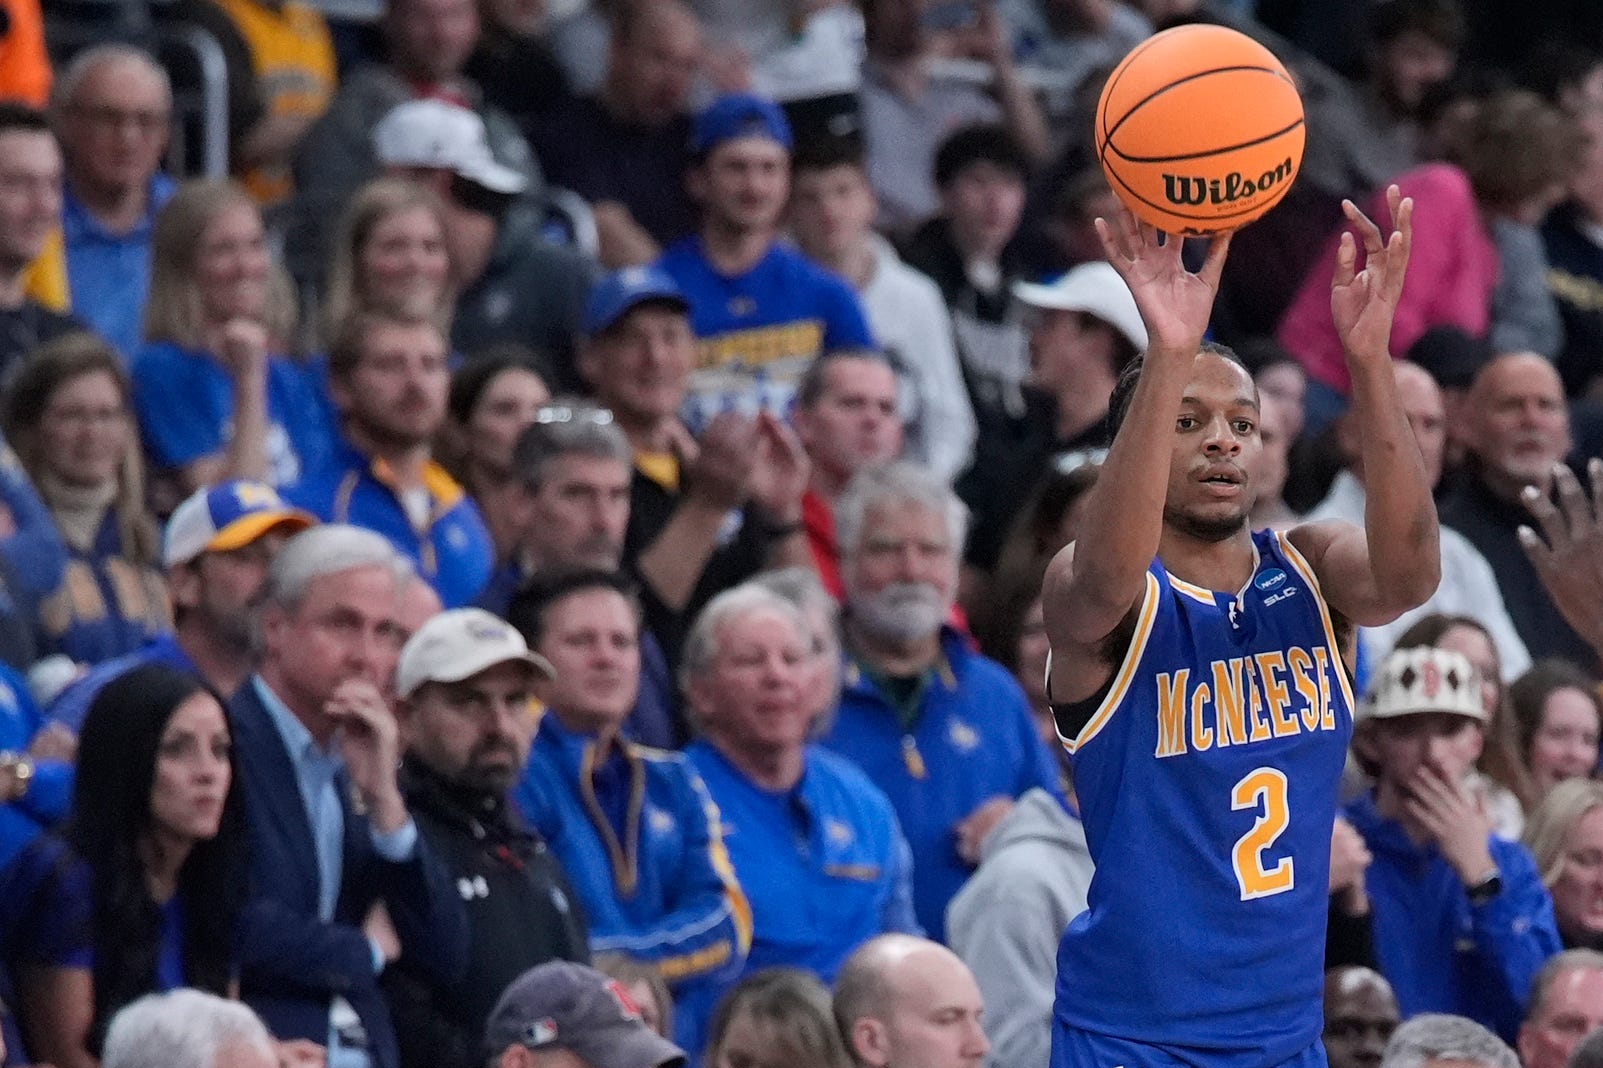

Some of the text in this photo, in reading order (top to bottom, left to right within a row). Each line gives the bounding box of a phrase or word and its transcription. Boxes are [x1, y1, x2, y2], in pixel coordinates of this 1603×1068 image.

[1162, 157, 1292, 205] Wilson
[1261, 572, 1286, 589] NCAA
[1231, 766, 1294, 901] 2
